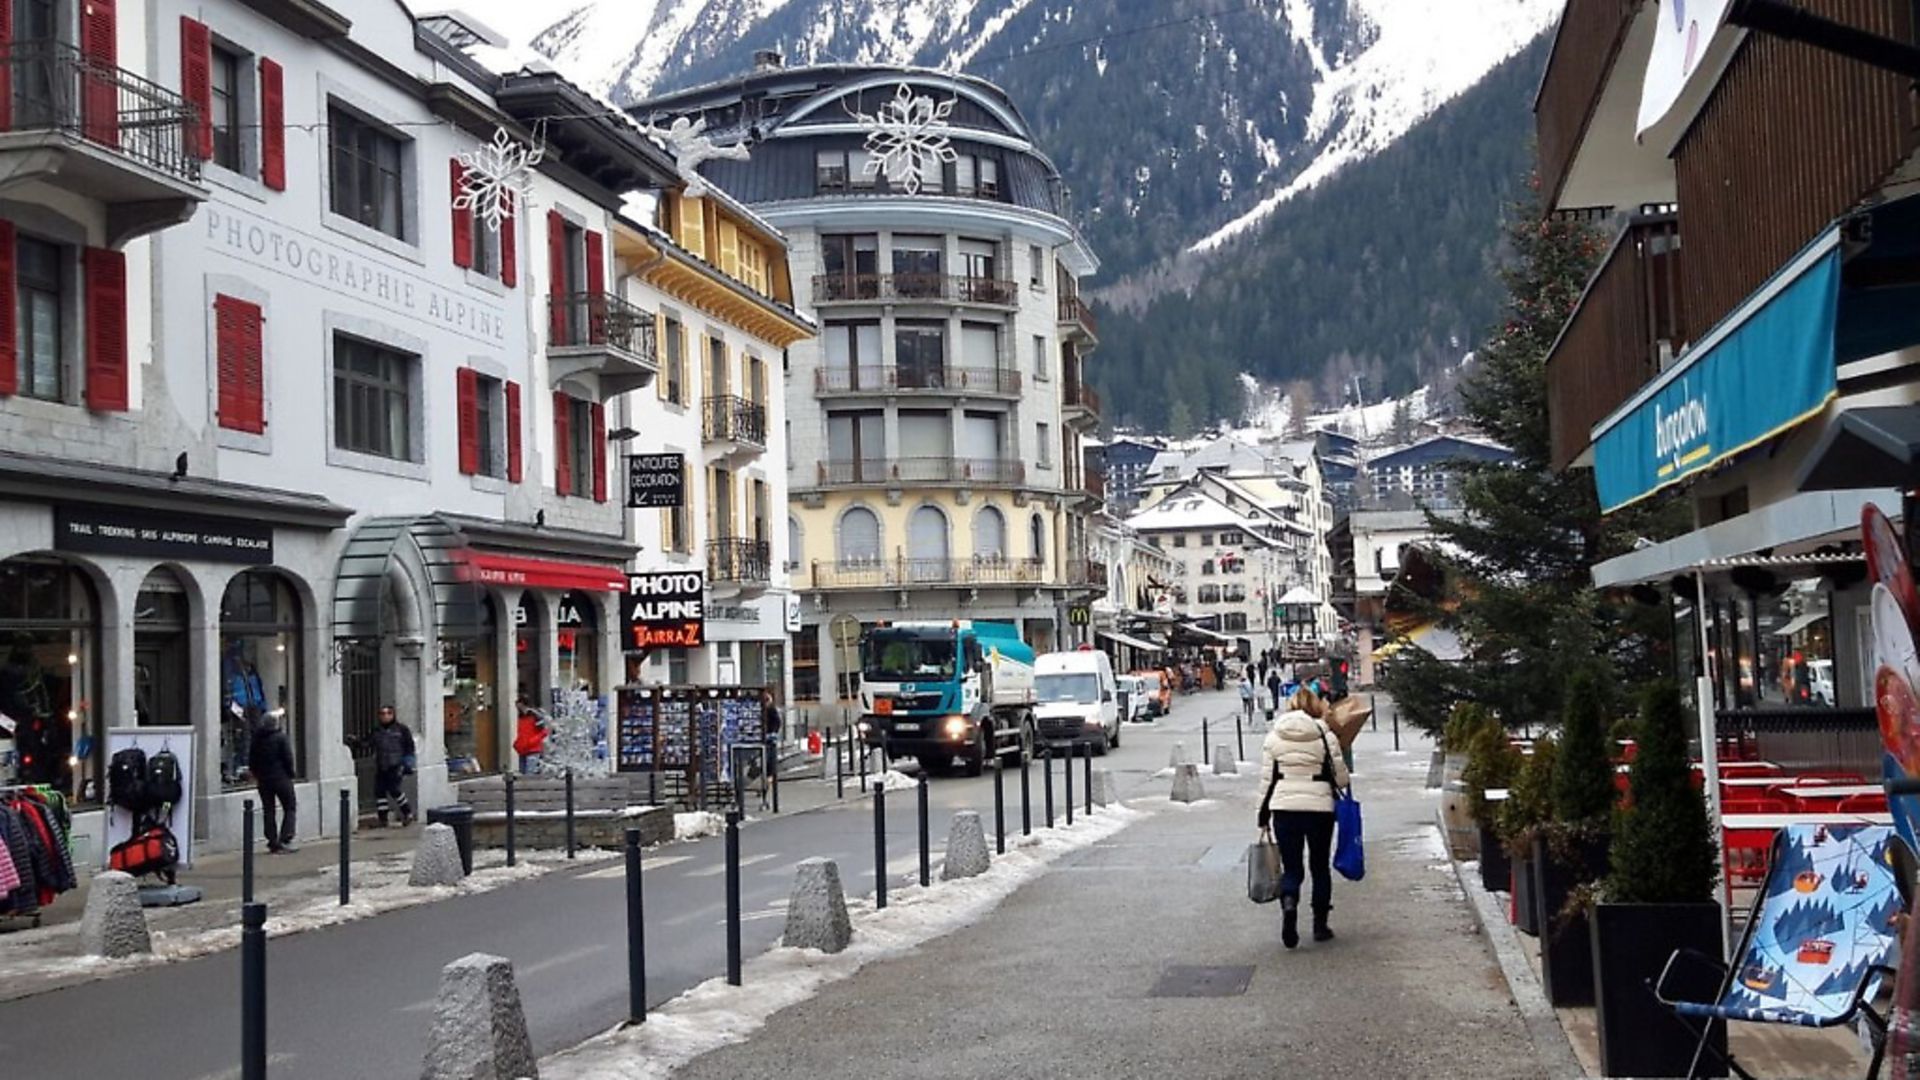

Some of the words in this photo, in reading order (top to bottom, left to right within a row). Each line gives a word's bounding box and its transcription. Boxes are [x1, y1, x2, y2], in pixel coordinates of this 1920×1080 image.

[206, 209, 415, 309] PHOTOGRAPHIE
[428, 293, 505, 339] ALPINE
[630, 574, 700, 596] PHOTO
[631, 601, 702, 621] ALPINE
[634, 623, 700, 647] TAIRRAZ
